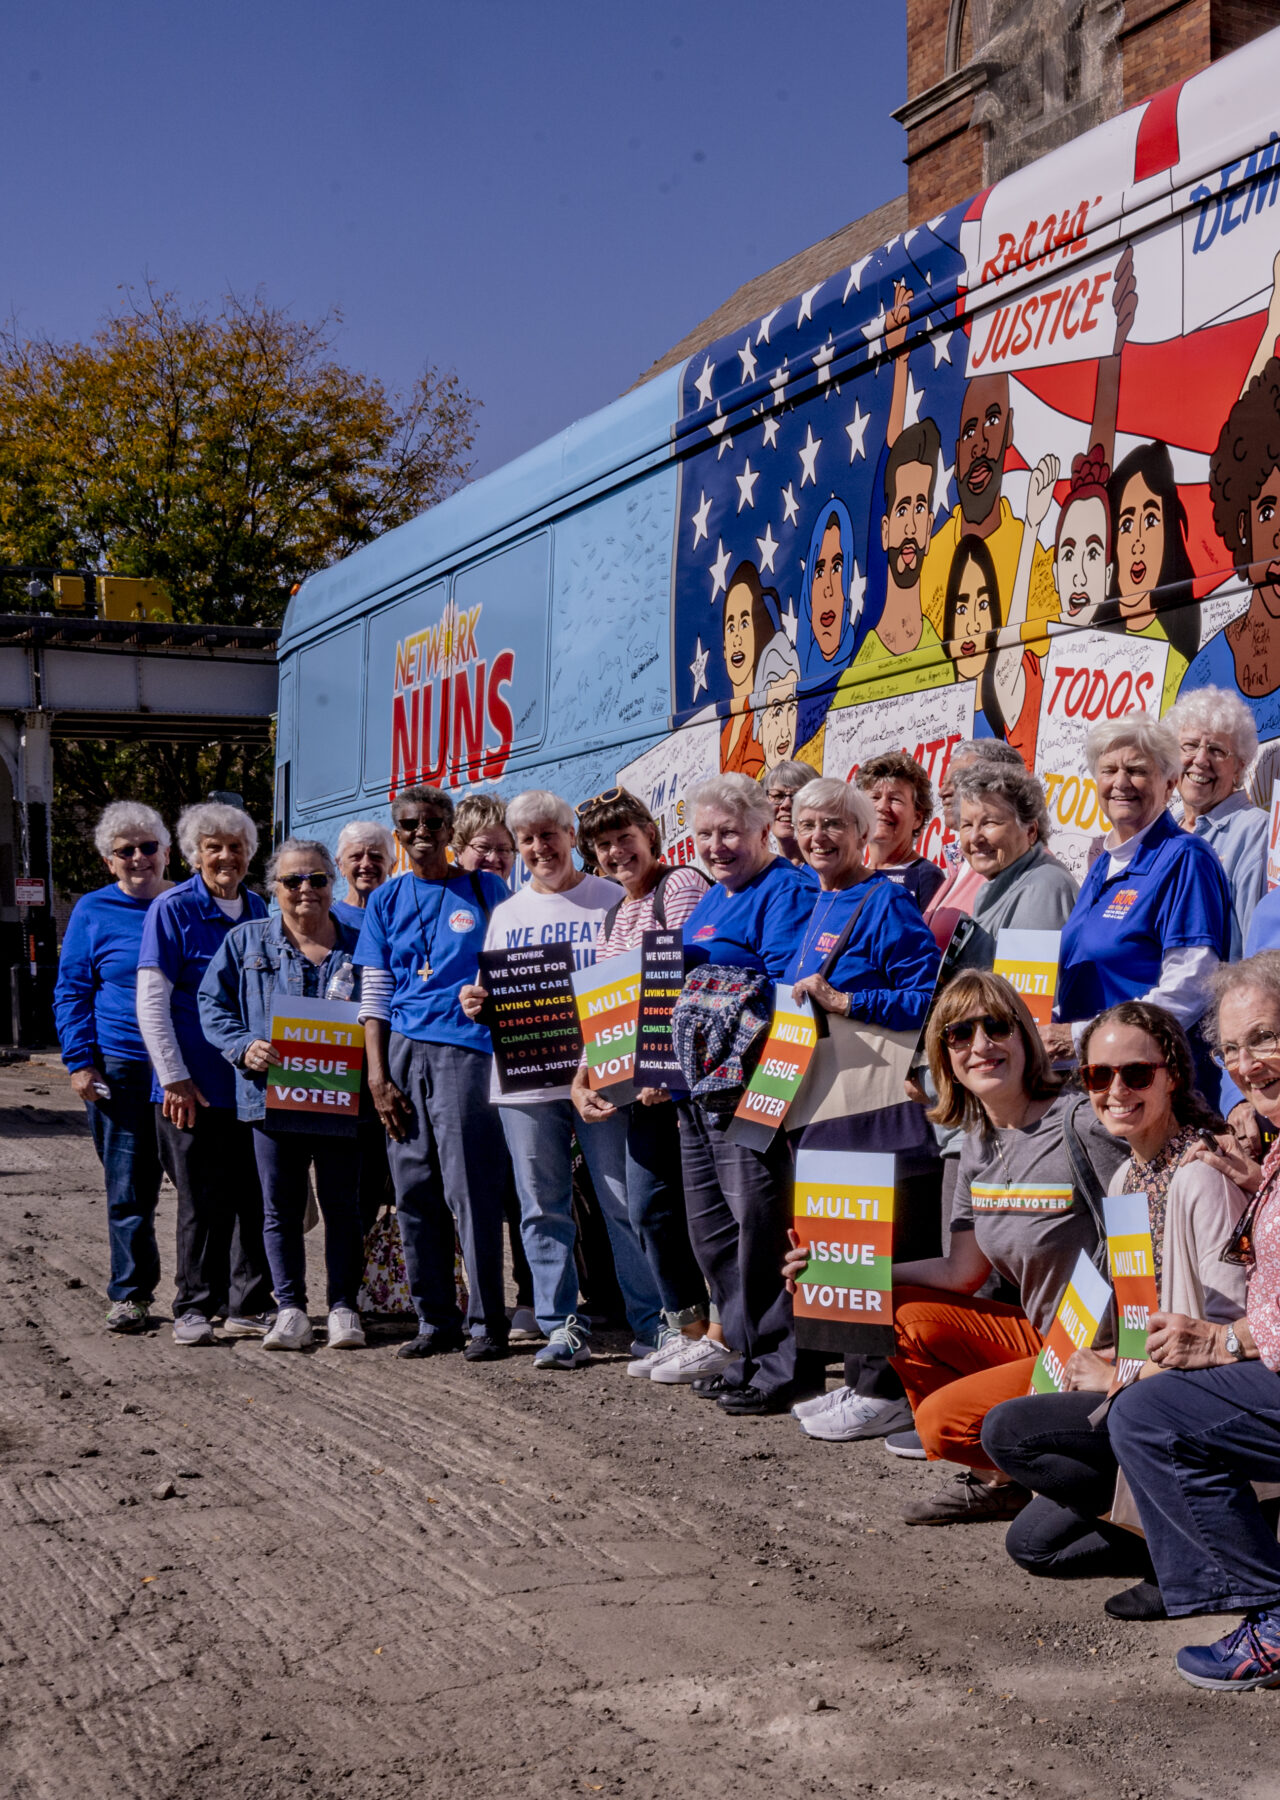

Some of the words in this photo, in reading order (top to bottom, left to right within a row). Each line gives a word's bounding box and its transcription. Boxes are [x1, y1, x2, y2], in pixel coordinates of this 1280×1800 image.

[982, 195, 1103, 286] RACIAL
[971, 271, 1114, 370] JUSTICE
[1047, 666, 1154, 721] TODOS
[388, 648, 515, 803] NUNS
[505, 926, 535, 949] WE
[645, 951, 657, 961] WE
[657, 951, 672, 961] VOTE
[672, 951, 682, 960] FOR
[489, 968, 509, 979] WE
[510, 964, 543, 977] VOTE
[543, 961, 568, 972] FOR
[645, 970, 669, 980] HEALTH
[492, 982, 537, 996] HEALTH
[644, 989, 665, 998] LIVING
[495, 1000, 532, 1013] LIVING
[534, 995, 573, 1007] WAGES
[499, 1010, 575, 1028] DEMOCRACY
[642, 1025, 664, 1034] CLIMATE
[283, 1025, 353, 1046] MULTI
[500, 1031, 541, 1045] CLIMATE
[542, 1026, 579, 1041] JUSTICE
[775, 1022, 813, 1046] MULTI
[506, 1042, 579, 1060] HOUSING
[282, 1055, 348, 1077] ISSUE
[506, 1063, 543, 1077] RACIAL
[594, 1052, 636, 1080] VOT
[640, 1060, 664, 1070] RACIAL
[762, 1057, 799, 1082] ISSUE
[274, 1085, 352, 1108] VOTER
[745, 1091, 786, 1118] VOTER
[806, 1195, 879, 1220] MULTI
[1023, 1198, 1067, 1209] VOTER
[809, 1240, 876, 1266] ISSUE
[1113, 1250, 1147, 1276] MULTI
[802, 1283, 883, 1312] VOTER
[1060, 1300, 1089, 1350] MULTI
